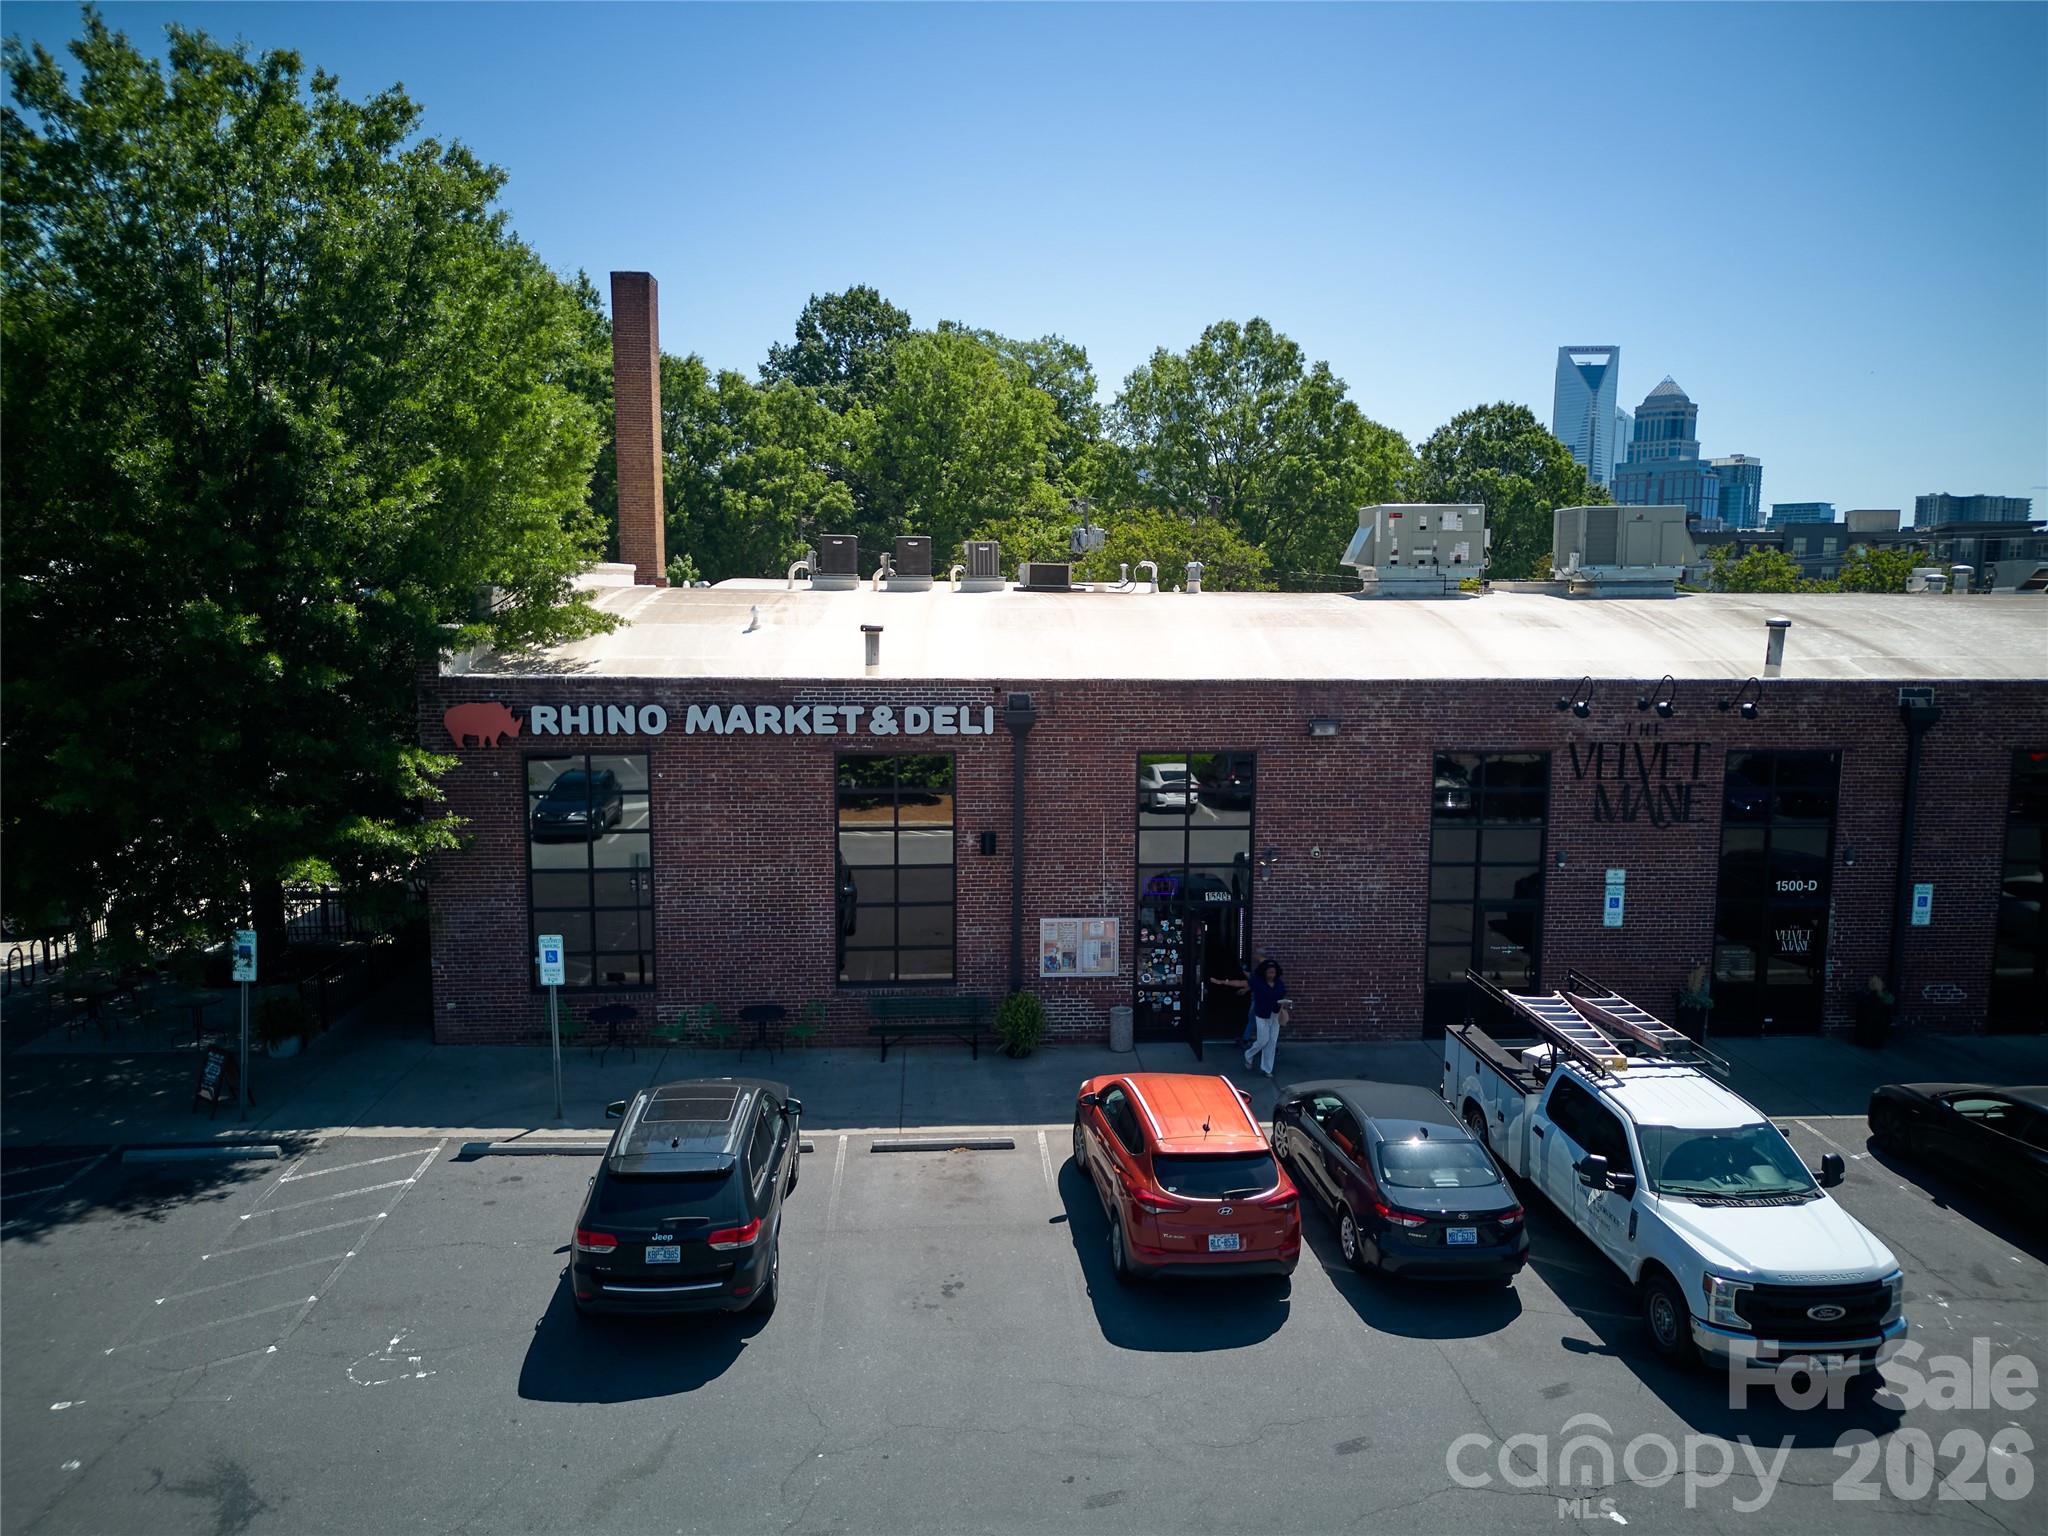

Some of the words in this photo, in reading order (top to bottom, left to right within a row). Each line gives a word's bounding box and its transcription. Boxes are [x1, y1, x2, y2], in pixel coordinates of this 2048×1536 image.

[531, 705, 667, 735] RHINO
[685, 705, 865, 735] MARKET
[869, 705, 899, 735] &
[904, 705, 994, 735] DELI
[1568, 741, 1711, 781] VELVET
[1593, 783, 1708, 829] MANE
[1776, 880, 1818, 891] 1500-D
[652, 1233, 673, 1242] Jeep
[1831, 1271, 1864, 1280] DUTY
